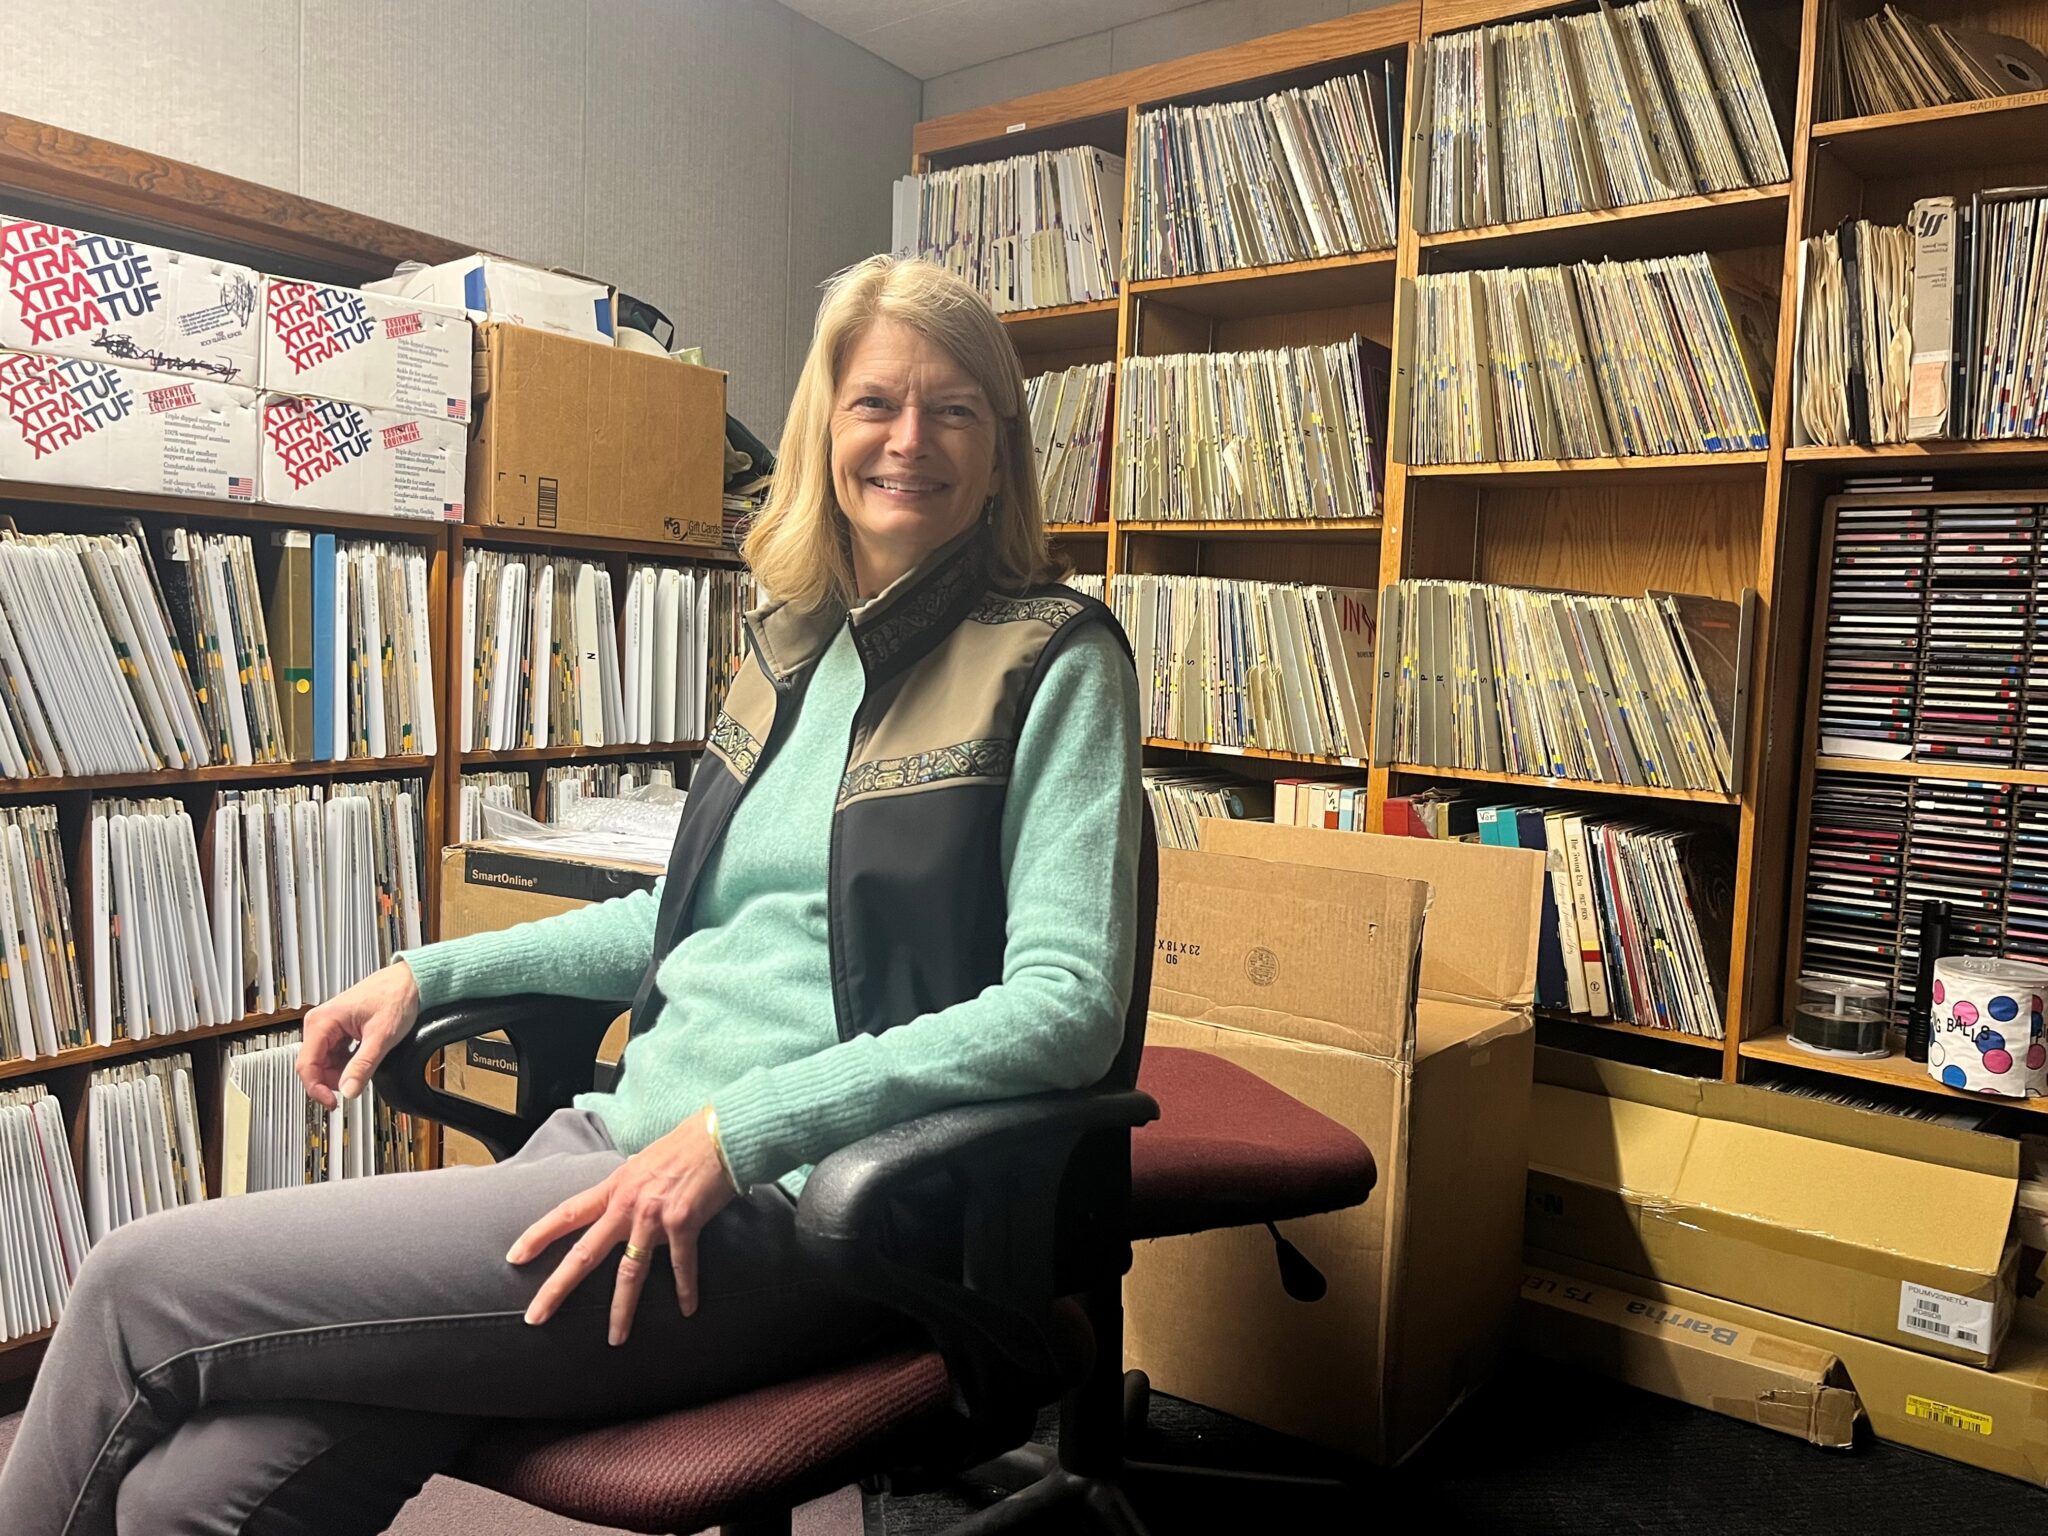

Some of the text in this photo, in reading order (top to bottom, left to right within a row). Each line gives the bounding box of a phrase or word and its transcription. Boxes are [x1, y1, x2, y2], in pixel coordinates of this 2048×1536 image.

[10, 255, 152, 317] XTRATUF
[20, 283, 161, 346] XTRATUF
[278, 297, 366, 354] XTRATUF
[386, 323, 420, 338] EQUIPMEN
[288, 318, 376, 375] XTRATUF
[148, 386, 193, 400] ESSENTIAL
[149, 394, 197, 412] EQUIPMENT
[11, 369, 121, 438] XTRATUF
[25, 391, 133, 460] XTRATUF
[277, 411, 363, 471] XTRATUF
[384, 431, 420, 447] EQUIPMENT
[287, 431, 372, 490] XTRATUF
[701, 521, 720, 535] Cards
[587, 652, 596, 660] N
[472, 869, 533, 887] SmartOnline
[1158, 939, 1200, 956] 23 X 18 X
[1166, 953, 1178, 965] 9D
[1946, 1015, 1991, 1043] BALLS
[472, 1052, 518, 1072] SmartOnli
[1521, 1274, 1558, 1293] LE
[1626, 1300, 1739, 1346] Barrina
